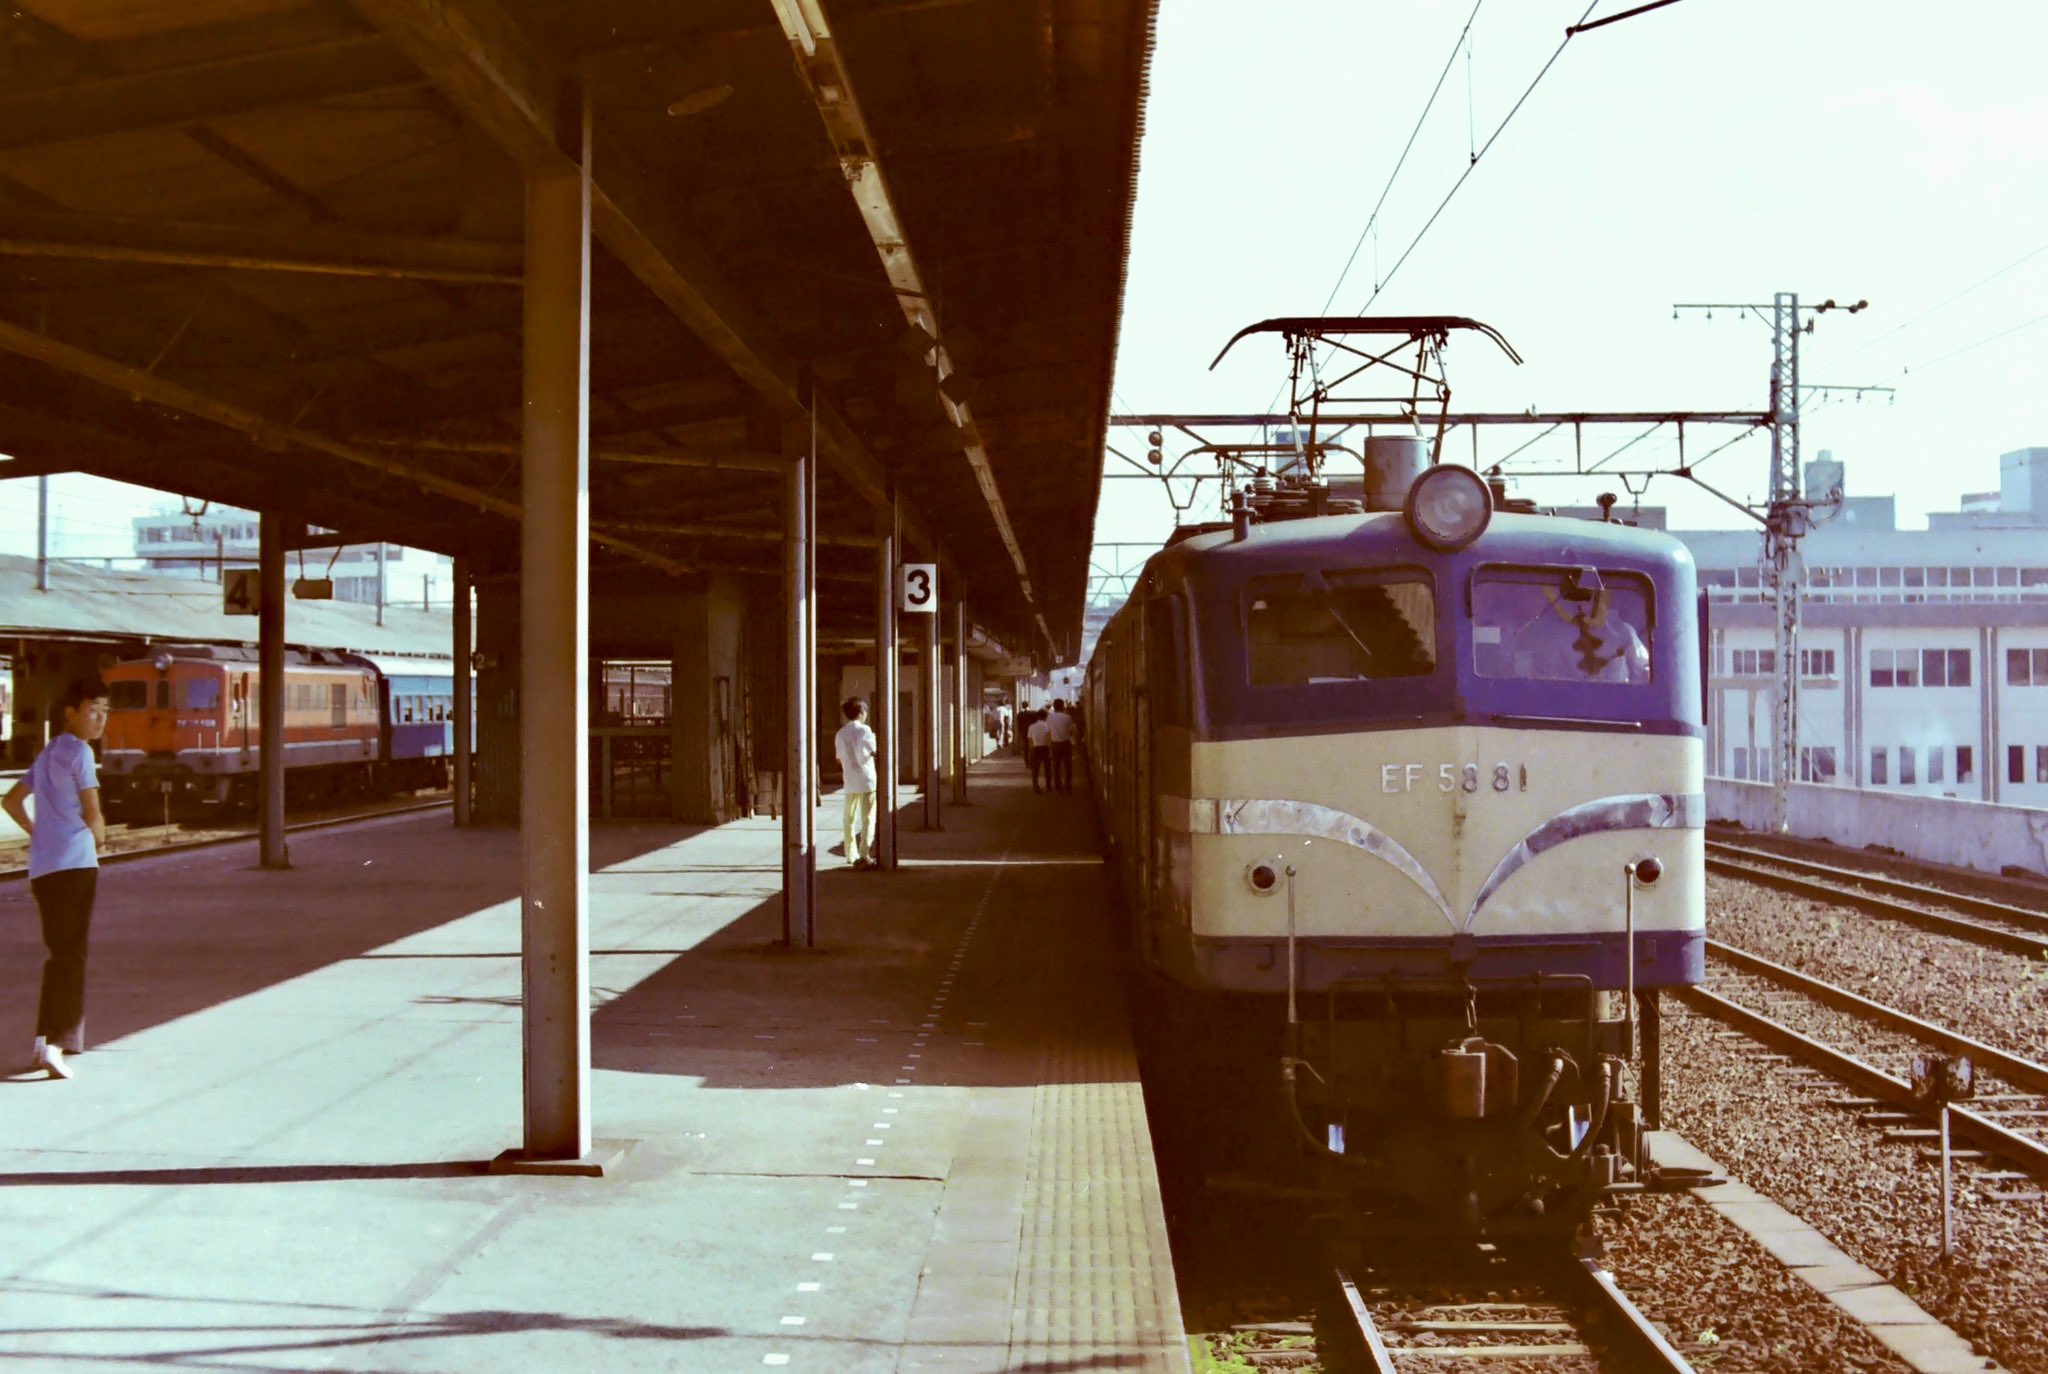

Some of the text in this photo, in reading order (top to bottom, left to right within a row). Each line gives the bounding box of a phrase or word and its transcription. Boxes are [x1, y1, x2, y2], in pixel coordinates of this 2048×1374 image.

[226, 574, 249, 608] 4
[907, 569, 931, 606] 3
[1381, 763, 1424, 793] EF
